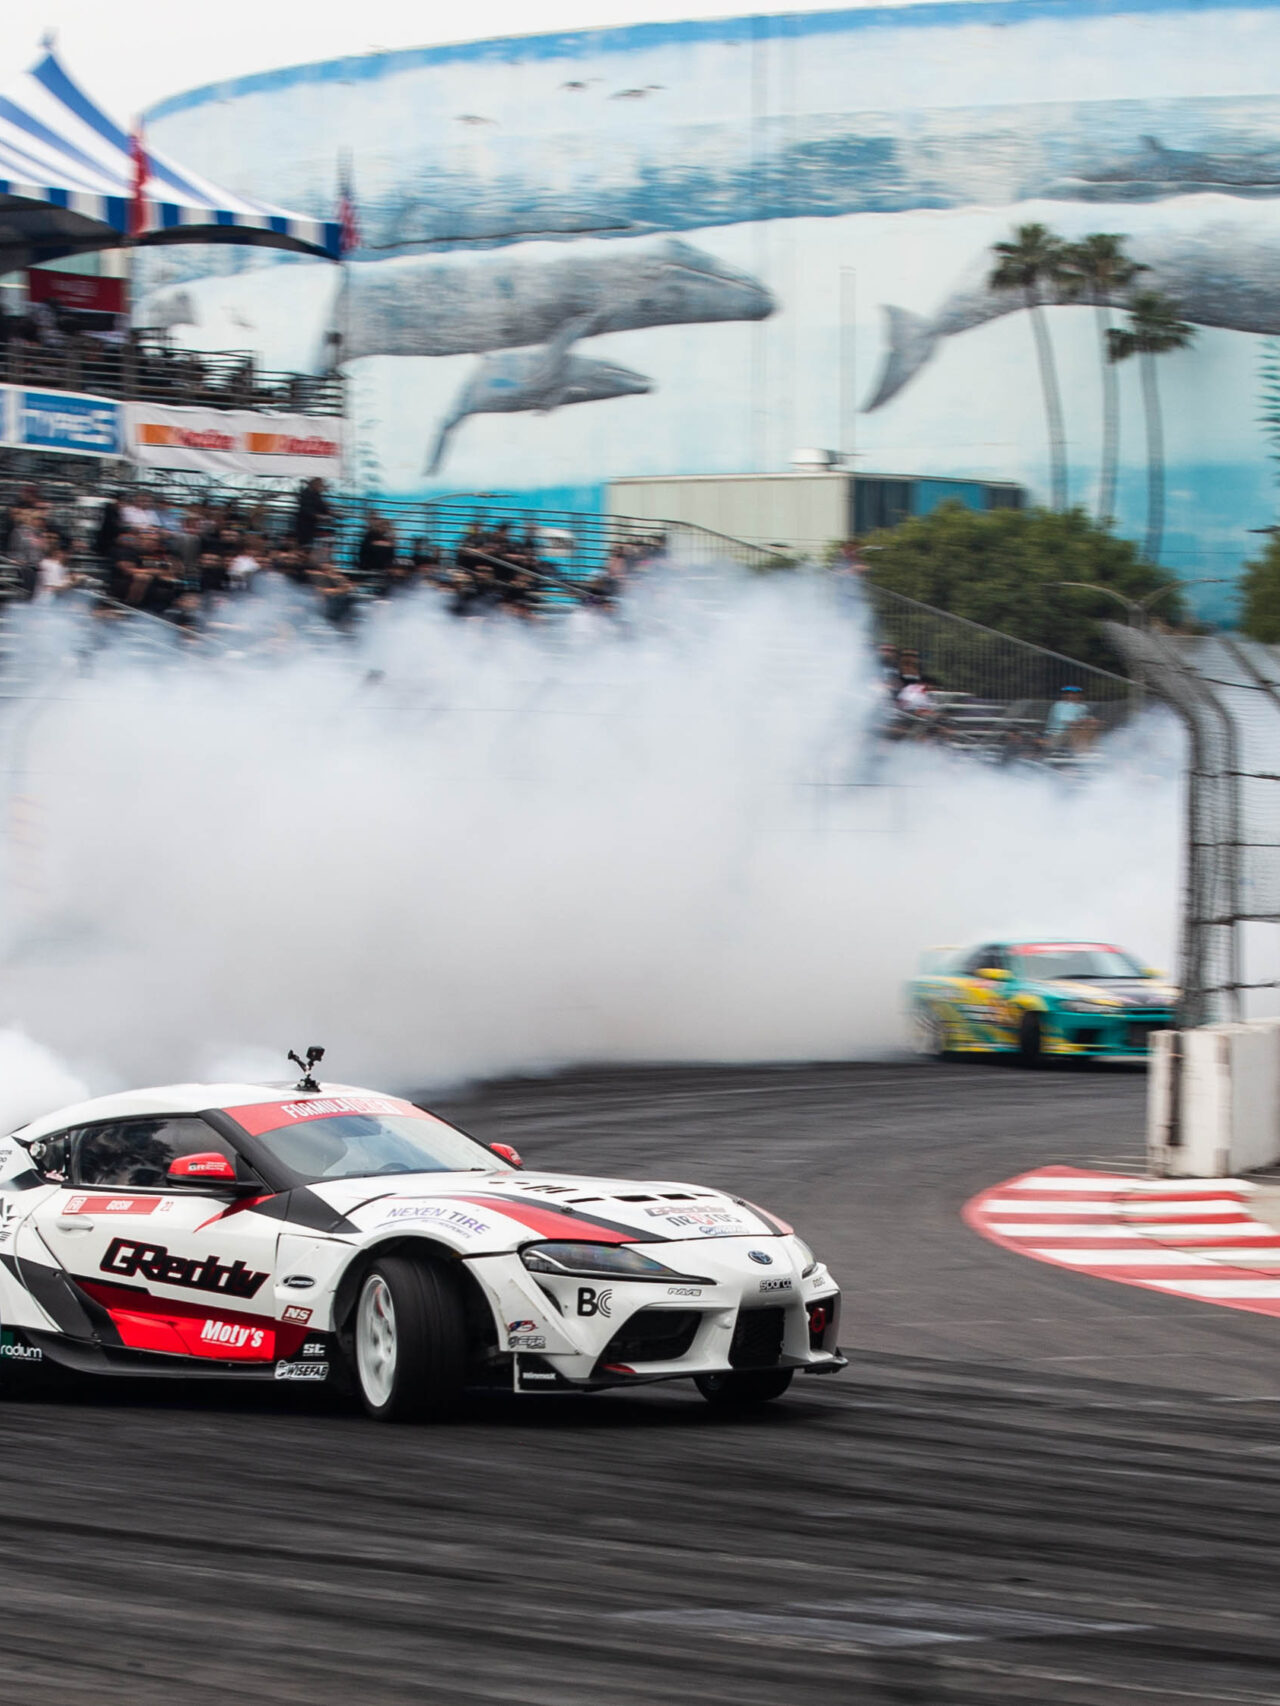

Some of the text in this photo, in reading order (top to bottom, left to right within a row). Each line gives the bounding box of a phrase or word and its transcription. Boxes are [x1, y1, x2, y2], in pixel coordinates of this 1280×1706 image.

[387, 1207, 447, 1218] NEXEN
[448, 1211, 491, 1235] TIRE
[100, 1237, 271, 1299] GReddy
[284, 1307, 311, 1321] NS
[200, 1319, 265, 1348] Moty's
[0, 1342, 43, 1359] radium
